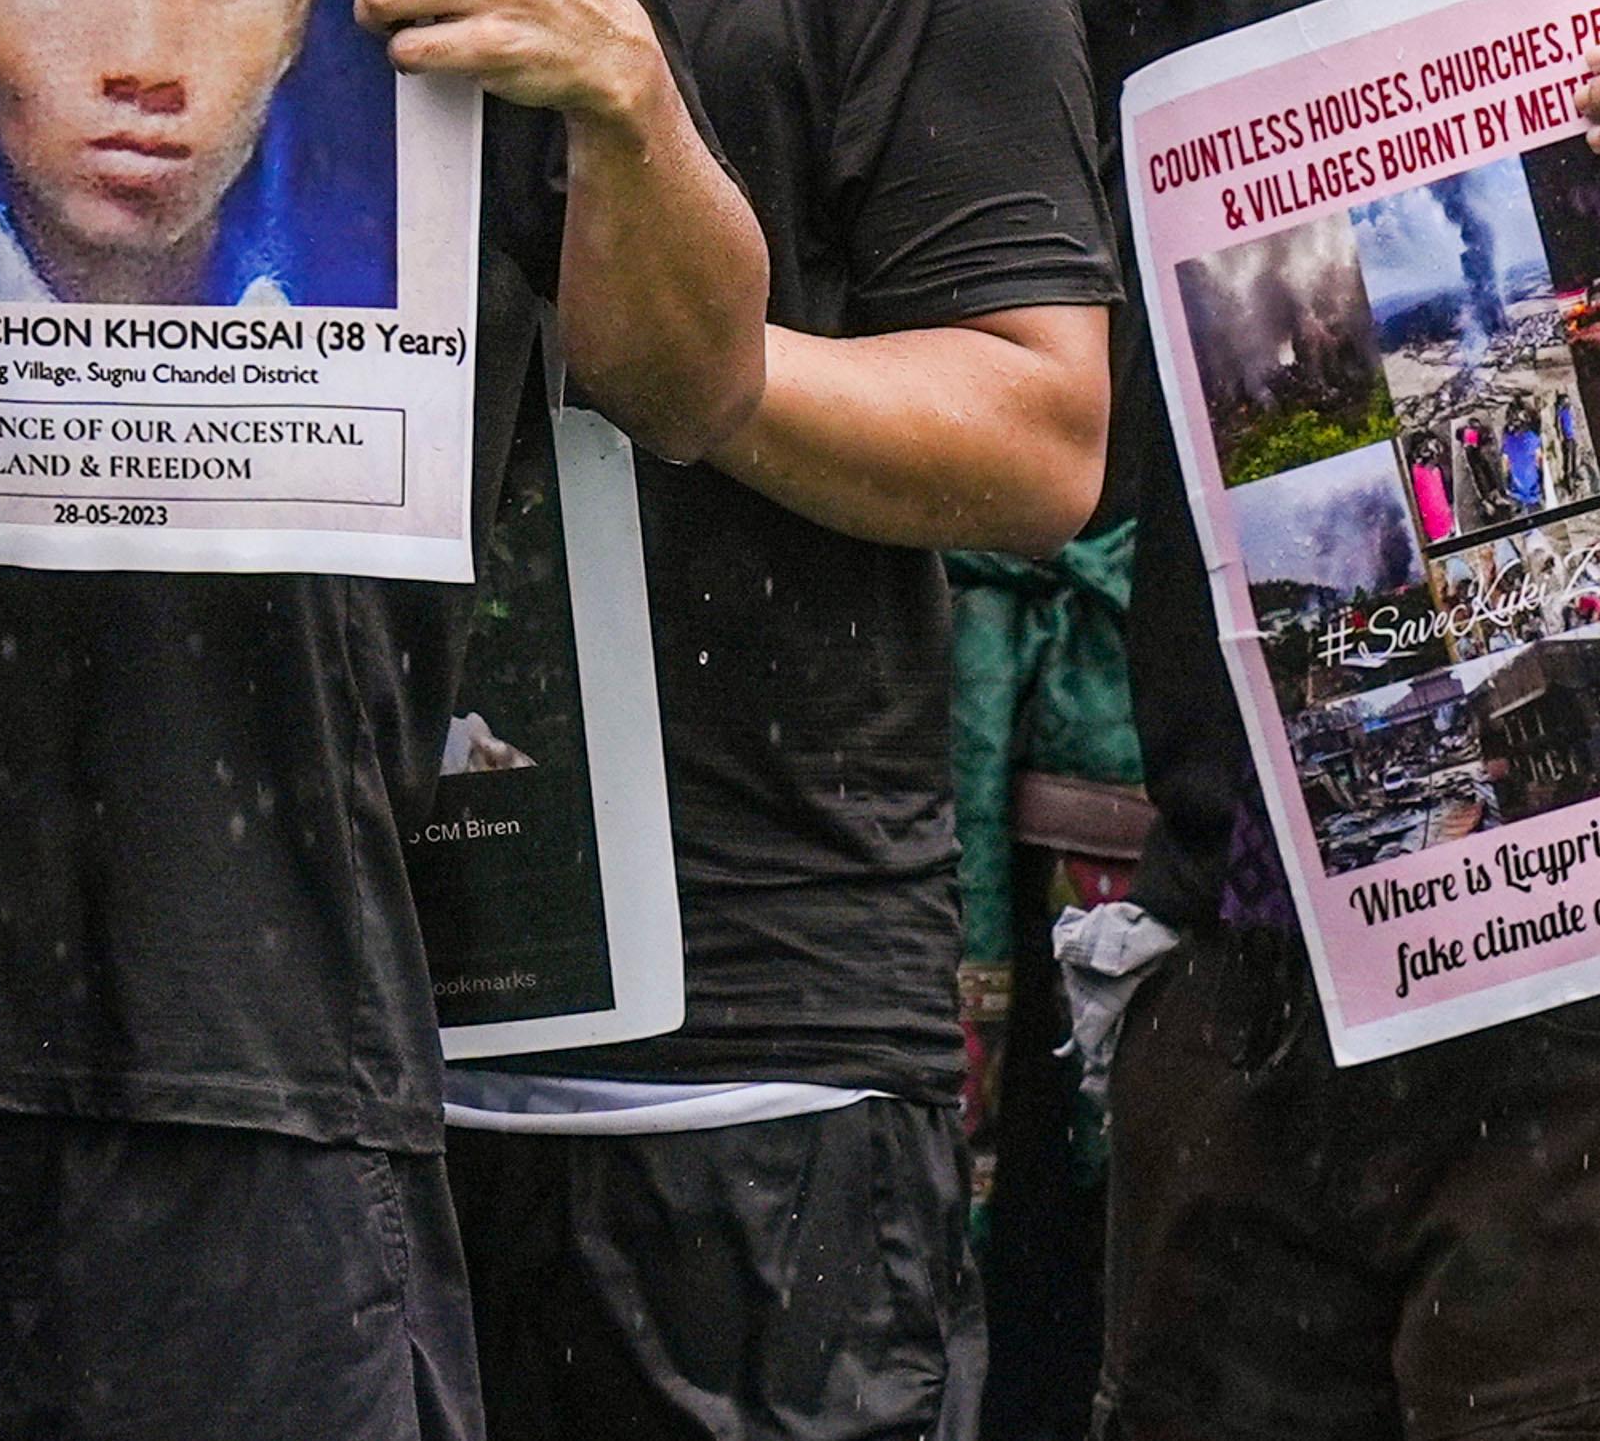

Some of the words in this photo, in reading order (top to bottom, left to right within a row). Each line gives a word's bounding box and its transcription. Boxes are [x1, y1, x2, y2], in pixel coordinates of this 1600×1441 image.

[1149, 109, 1305, 194] COUNTLESS
[1221, 188, 1248, 230] &
[1244, 146, 1376, 223] VILLAGES
[1377, 113, 1469, 181] BURNT
[1474, 100, 1511, 150] BY
[1515, 70, 1600, 136] MEIT
[104, 319, 304, 350] KHONGSAI
[316, 320, 365, 359] (38
[376, 324, 467, 366] Years)
[87, 362, 147, 387] Sugnu
[153, 364, 236, 384] Chandel
[243, 365, 319, 385] District
[63, 418, 104, 440] OF
[111, 419, 177, 443] OUR
[184, 421, 363, 446] ANCESTRAL
[80, 455, 101, 477] &
[110, 456, 252, 480] FREEDOM
[54, 503, 168, 526] 28-05-2023
[425, 822, 460, 843] CM
[466, 819, 521, 839] Biren
[1350, 878, 1459, 926] Where
[1463, 857, 1492, 896] is
[1396, 937, 1466, 998] fake
[1473, 900, 1587, 961] climate
[433, 970, 537, 996] ookmarks
